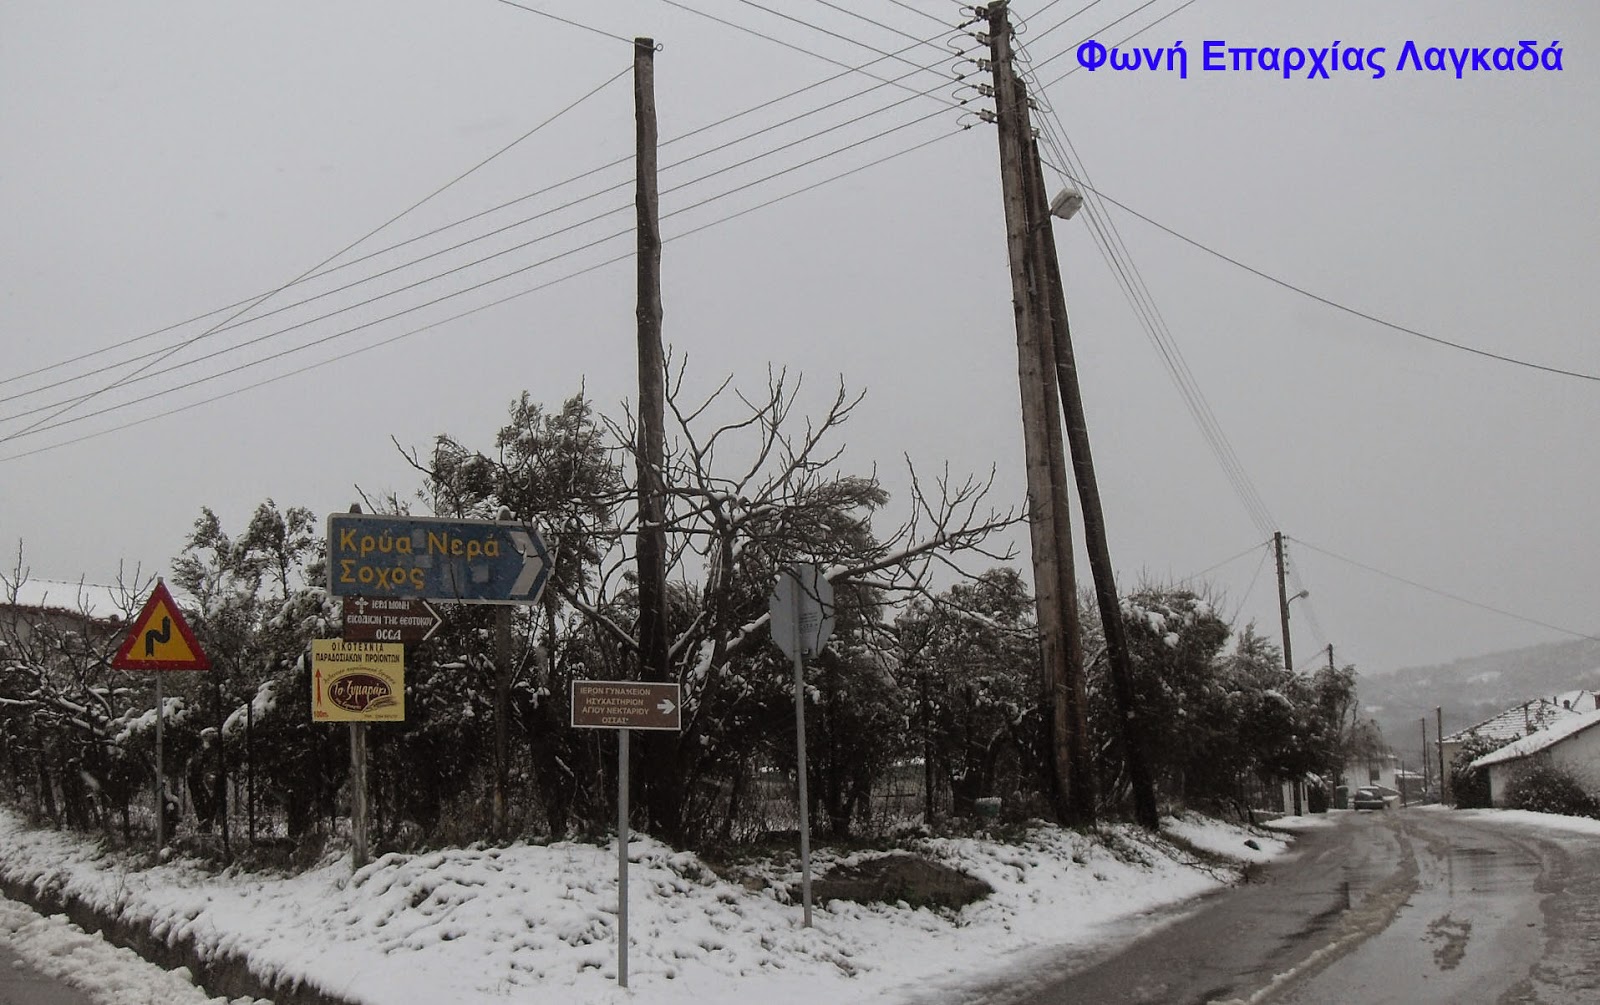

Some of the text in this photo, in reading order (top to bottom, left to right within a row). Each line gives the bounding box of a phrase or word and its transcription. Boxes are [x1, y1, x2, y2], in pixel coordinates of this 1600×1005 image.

[340, 527, 499, 561] Κρύα Νερά
[340, 559, 425, 590] Σοχός
[580, 687, 604, 695] ΙΕΡΟΝ
[582, 706, 649, 715] ΑΓΙΟΥ ΝΕΚΤΑΡΙΟΥ
